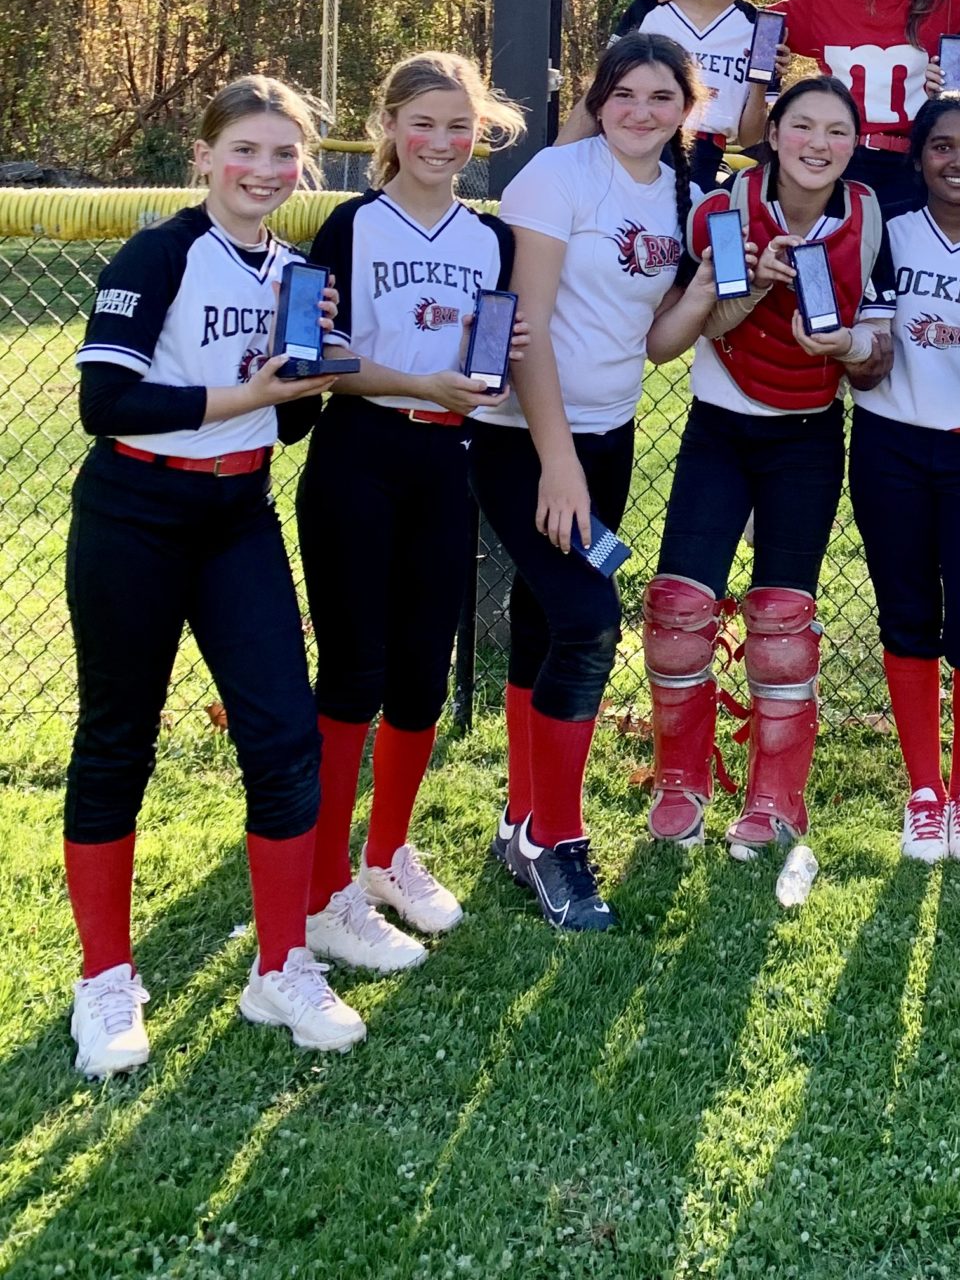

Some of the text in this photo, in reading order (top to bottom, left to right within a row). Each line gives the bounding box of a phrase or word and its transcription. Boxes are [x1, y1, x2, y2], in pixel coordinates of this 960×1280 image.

[691, 52, 746, 84] KETS
[372, 261, 483, 300] ROCKETS
[200, 305, 275, 348] ROCK
